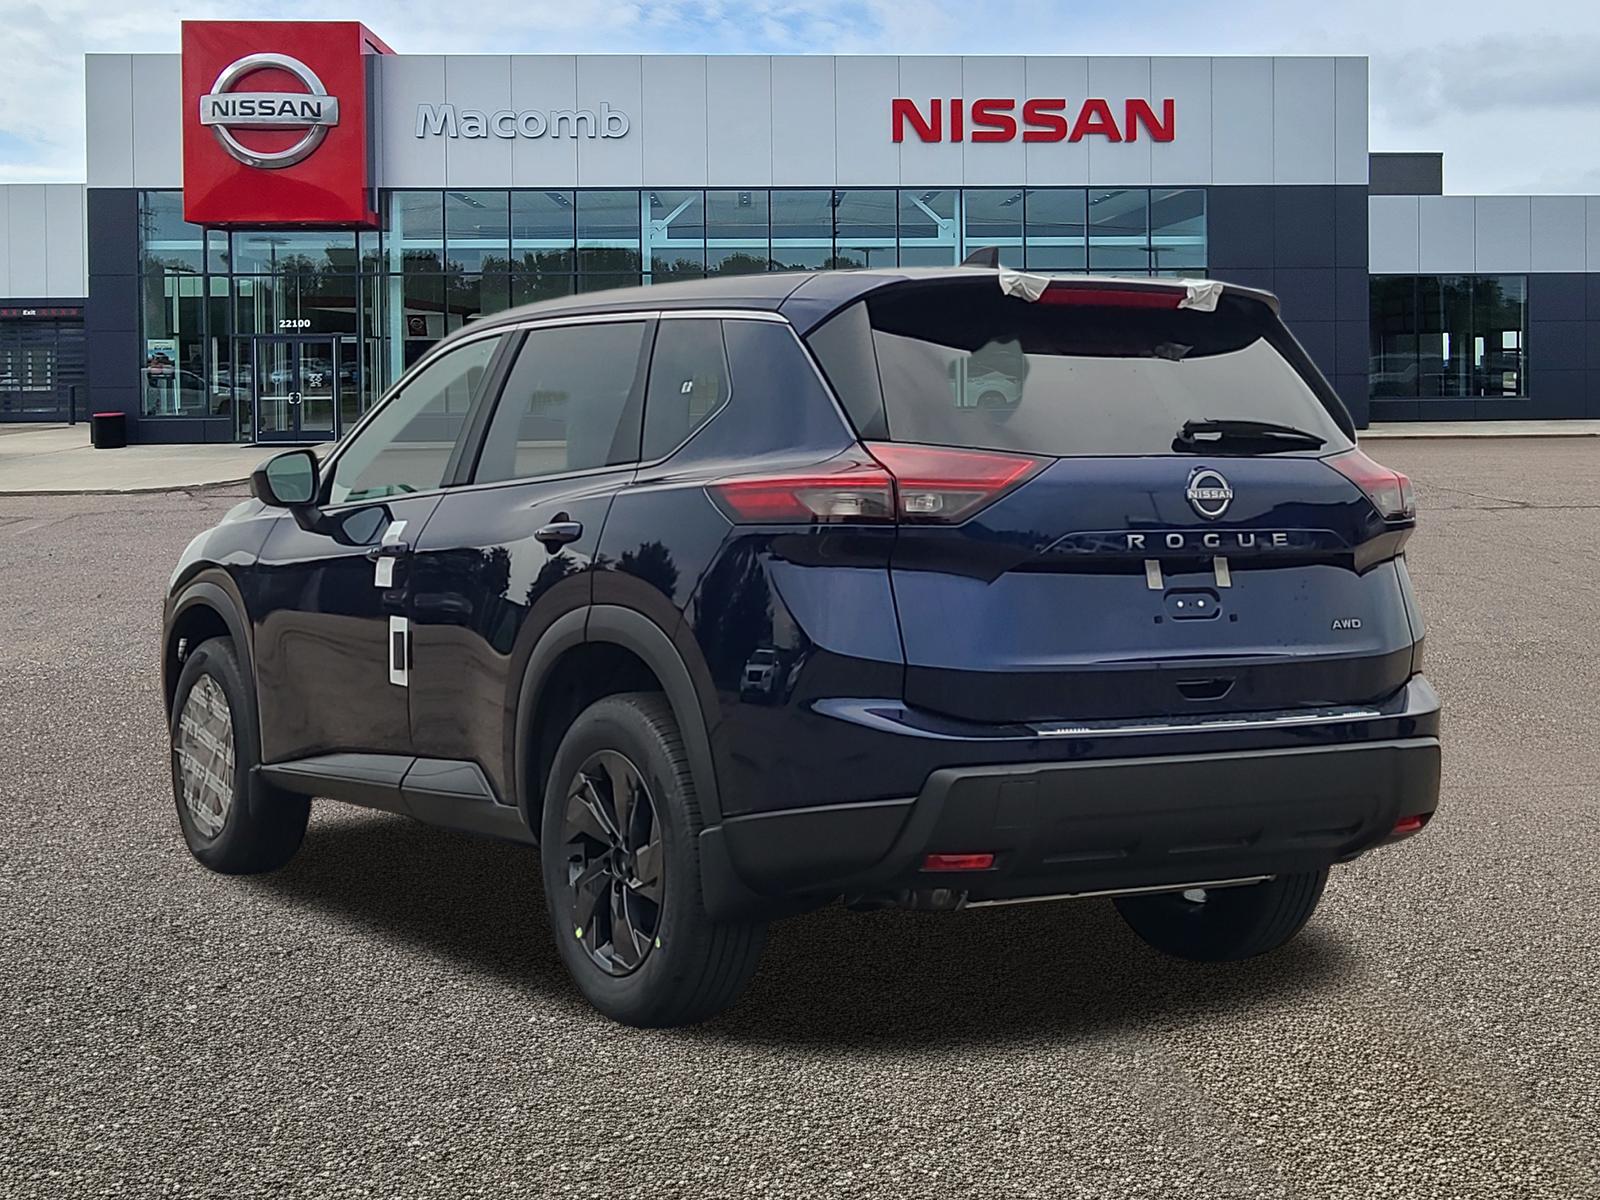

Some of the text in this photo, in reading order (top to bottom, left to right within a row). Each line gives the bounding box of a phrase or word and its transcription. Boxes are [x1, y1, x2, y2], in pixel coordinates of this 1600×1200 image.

[211, 100, 322, 118] NISSAN
[415, 102, 630, 139] Macomb
[892, 98, 1175, 143] NISSAN
[279, 319, 311, 328] 22100
[1187, 489, 1233, 499] NISSAN
[1127, 533, 1289, 550] ROGUE
[1332, 618, 1362, 630] AWD
